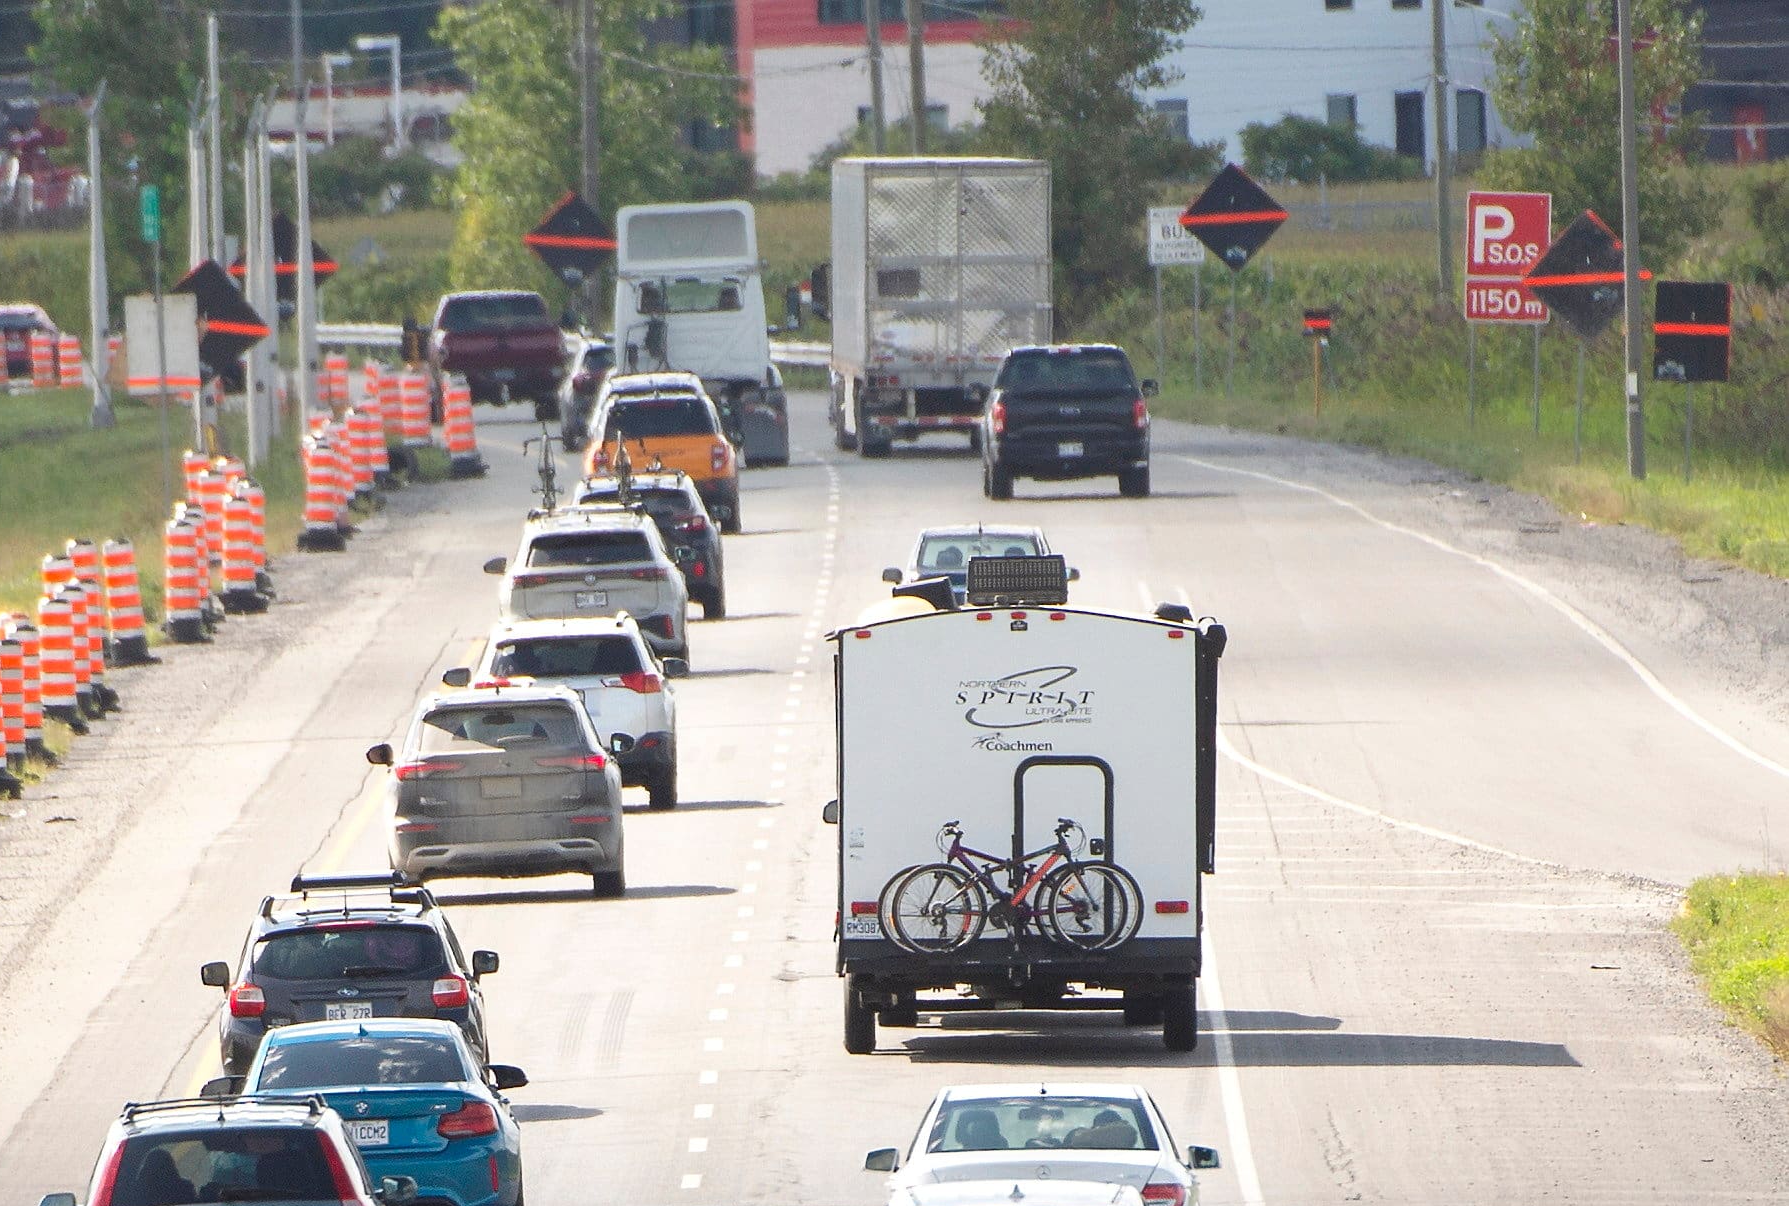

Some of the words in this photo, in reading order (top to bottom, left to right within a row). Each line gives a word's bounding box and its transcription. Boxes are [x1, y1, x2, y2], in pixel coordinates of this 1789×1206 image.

[1474, 205, 1515, 263] P
[1472, 289, 1521, 314] 1150
[1525, 301, 1542, 314] m
[955, 691, 1096, 705] SPIRIT
[986, 741, 1053, 751] Coachmen
